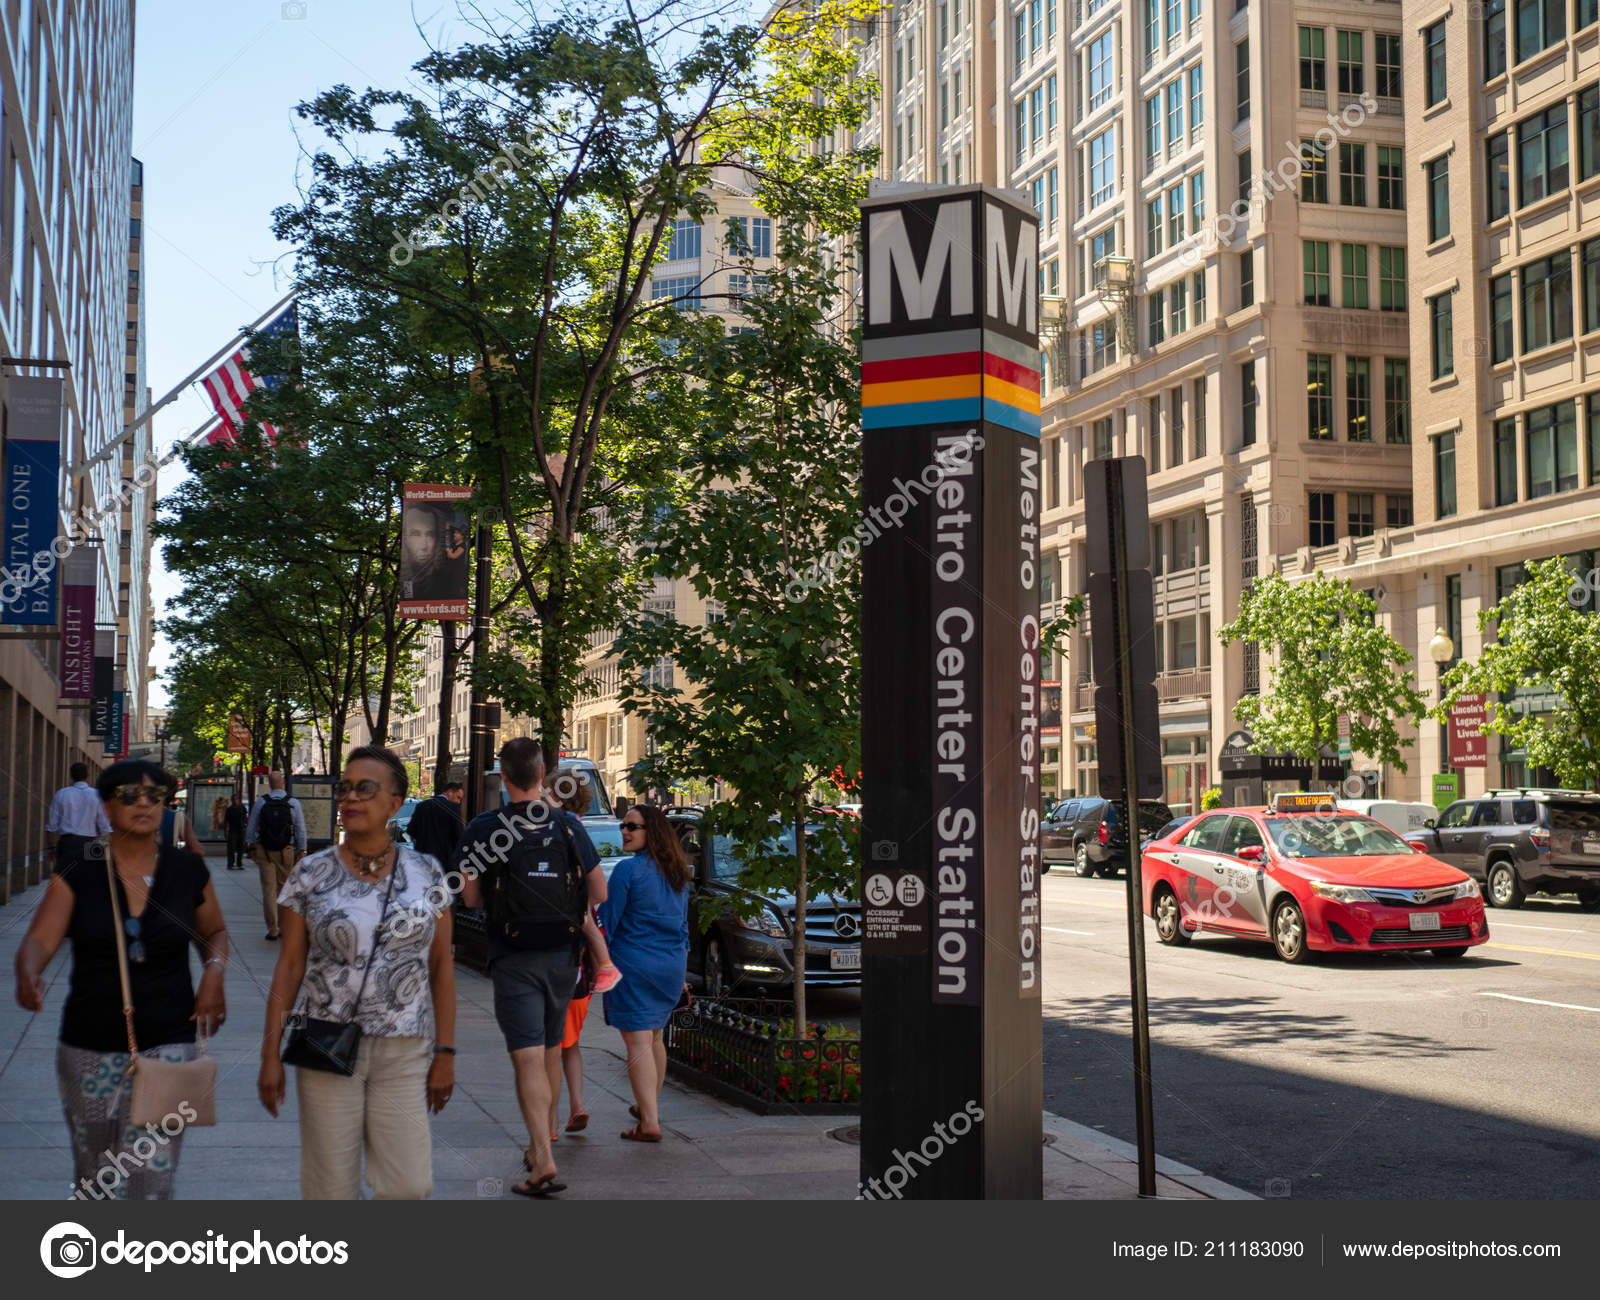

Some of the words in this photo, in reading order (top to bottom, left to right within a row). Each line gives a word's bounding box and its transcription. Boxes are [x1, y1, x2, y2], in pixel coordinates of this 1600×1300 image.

[869, 200, 973, 325] M
[985, 202, 1037, 335] M
[12, 464, 32, 511] ONE
[936, 435, 974, 582] Metro
[1020, 447, 1039, 590] Metro
[65, 605, 82, 692] INSIGHT
[402, 604, 466, 615] www.fords.org
[96, 696, 107, 731] PAUL
[936, 606, 974, 783] Center
[1020, 614, 1039, 783] Center
[1451, 704, 1484, 715] Lincoln's
[1455, 717, 1482, 728] Legacy
[866, 909, 904, 917] ACCESSIBLE
[891, 924, 922, 932] BETWEEN
[937, 806, 976, 994] Station
[1020, 807, 1039, 989] Station
